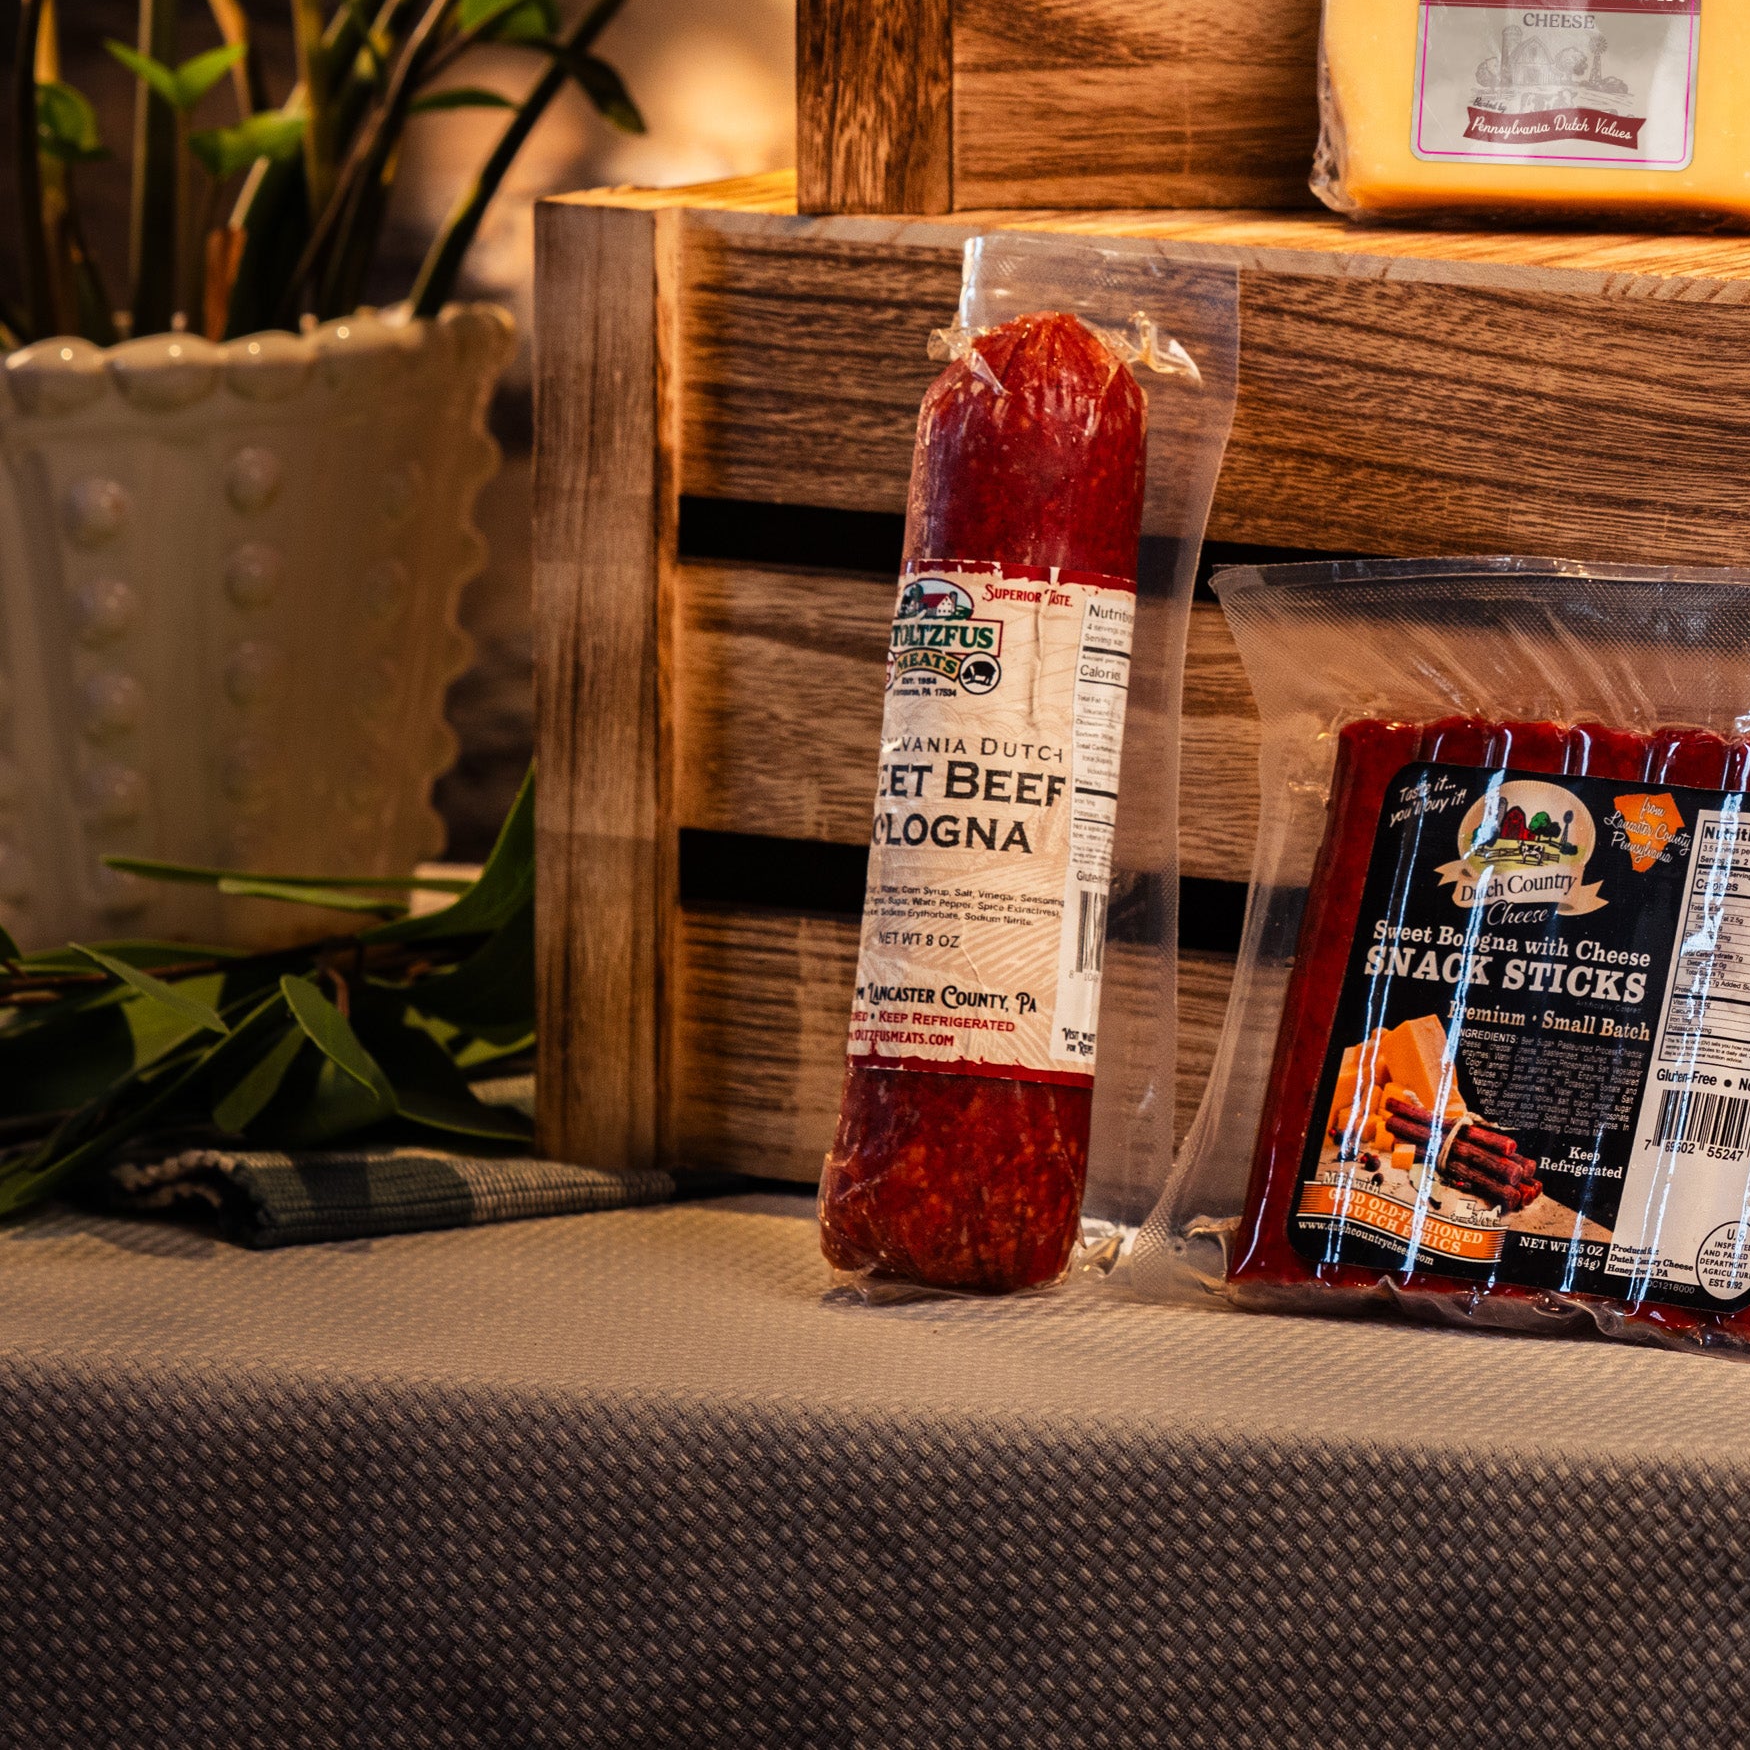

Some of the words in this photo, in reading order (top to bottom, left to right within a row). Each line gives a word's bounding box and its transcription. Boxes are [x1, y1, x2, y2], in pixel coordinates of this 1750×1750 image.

[1523, 13, 1595, 30] CHEESE
[1496, 103, 1506, 113] by
[1472, 117, 1550, 139] Pennsylvania
[1554, 114, 1589, 131] Dutch
[1595, 118, 1632, 139] Values
[982, 584, 1041, 603] SUPERIOR
[892, 624, 993, 649] TOLTZFUS
[898, 652, 957, 674] MEATS
[1080, 665, 1121, 681] Calories
[944, 760, 1066, 807] BEEF
[1424, 798, 1447, 816] buy
[1450, 789, 1467, 807] it!
[1639, 797, 1665, 818] from
[873, 813, 1032, 854] OLOGNA
[1604, 810, 1652, 837] Lancaster
[1653, 823, 1692, 856] County
[1611, 831, 1673, 864] Pennsylvania
[1700, 855, 1725, 867] Servng
[1744, 858, 1749, 866] 2
[1508, 872, 1578, 896] Country
[1695, 879, 1738, 892] Caores
[1487, 901, 1548, 927] Cheese
[879, 932, 898, 945] NET
[902, 933, 922, 946] WT
[926, 934, 934, 946] 8
[939, 935, 960, 948] OZ
[1373, 919, 1432, 943] Sweet
[1436, 925, 1518, 955] Bologna
[1525, 936, 1569, 957] with
[1576, 940, 1651, 967] Cheese
[1364, 945, 1493, 985] SNACK
[1502, 958, 1647, 1004] STICKS
[1721, 981, 1741, 989] Added
[868, 982, 935, 1006] LANCASTER
[941, 985, 1009, 1012] COUNTY,
[1016, 992, 1036, 1015] PA
[879, 1010, 908, 1024] KEEP
[912, 1012, 1014, 1032] REFRIGERATED
[1447, 1000, 1525, 1026] Premium
[1542, 1009, 1596, 1035] Small
[1599, 1018, 1650, 1042] Batch
[1459, 1028, 1518, 1044] NGREDIENTS:
[1569, 1146, 1600, 1163] Keep
[1644, 1139, 1652, 1150] 7
[1706, 1147, 1744, 1162] 55247
[1539, 1156, 1622, 1178] Refrigerated
[1356, 1179, 1381, 1195] with
[1368, 1197, 1483, 1245] OLD-FAHIONED
[1402, 1226, 1461, 1254] EHICS
[1519, 1236, 1548, 1249] NET
[1550, 1240, 1569, 1253] WT
[1587, 1244, 1604, 1257] OZ
[1609, 1254, 1634, 1265] Dutch
[1663, 1258, 1694, 1272] Cheese
[1703, 1249, 1721, 1258] AND
[1607, 1264, 1634, 1275] Honey
[1657, 1268, 1669, 1278] PA
